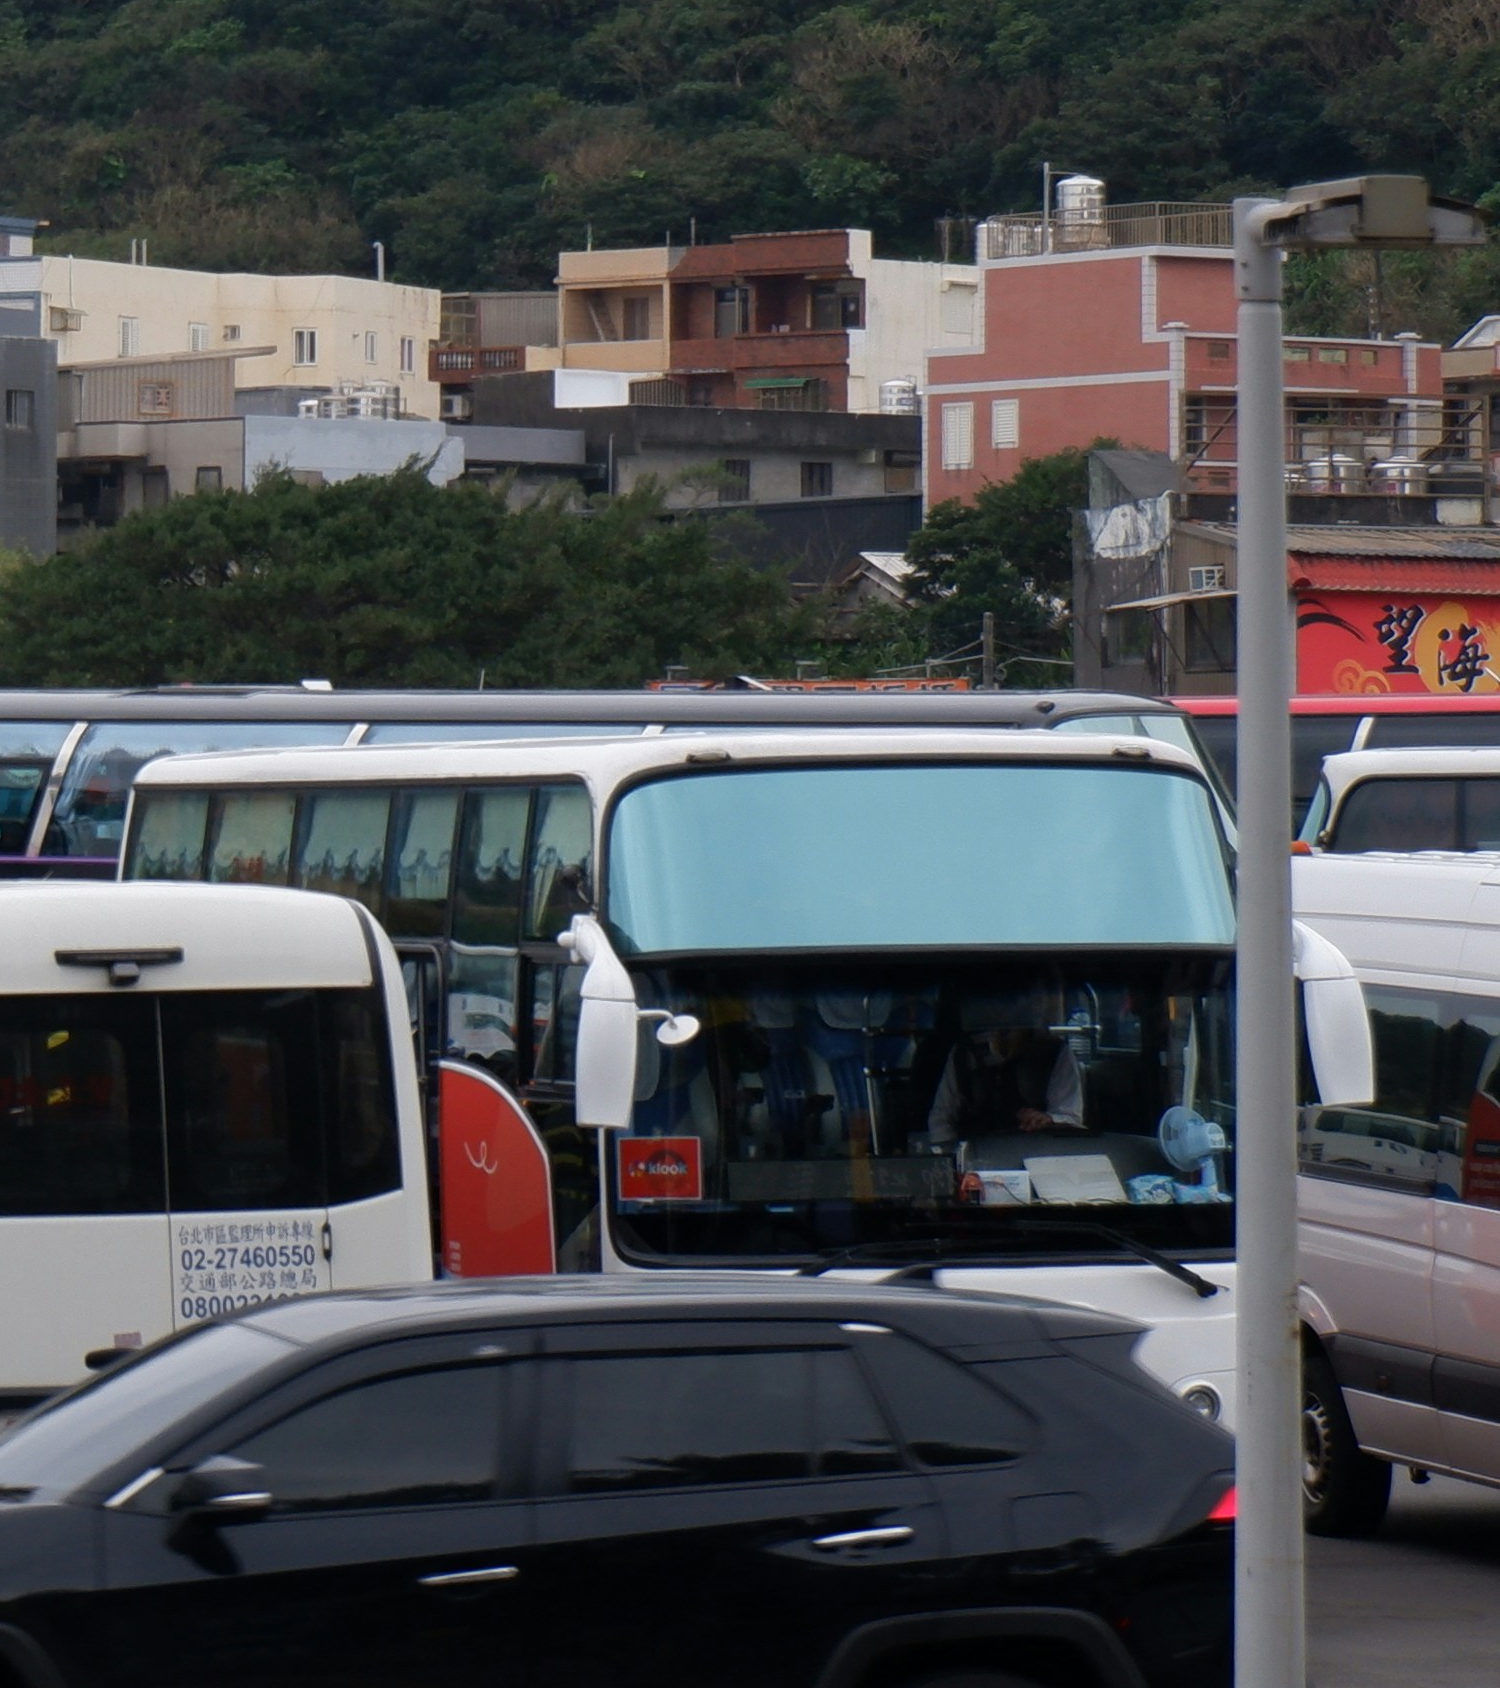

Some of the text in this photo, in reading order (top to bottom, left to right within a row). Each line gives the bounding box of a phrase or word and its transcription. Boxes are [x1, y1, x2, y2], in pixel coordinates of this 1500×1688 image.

[1373, 603, 1491, 693] 望海
[181, 1245, 315, 1271] 02-27460550
[181, 1269, 317, 1294] 交通部公路總局
